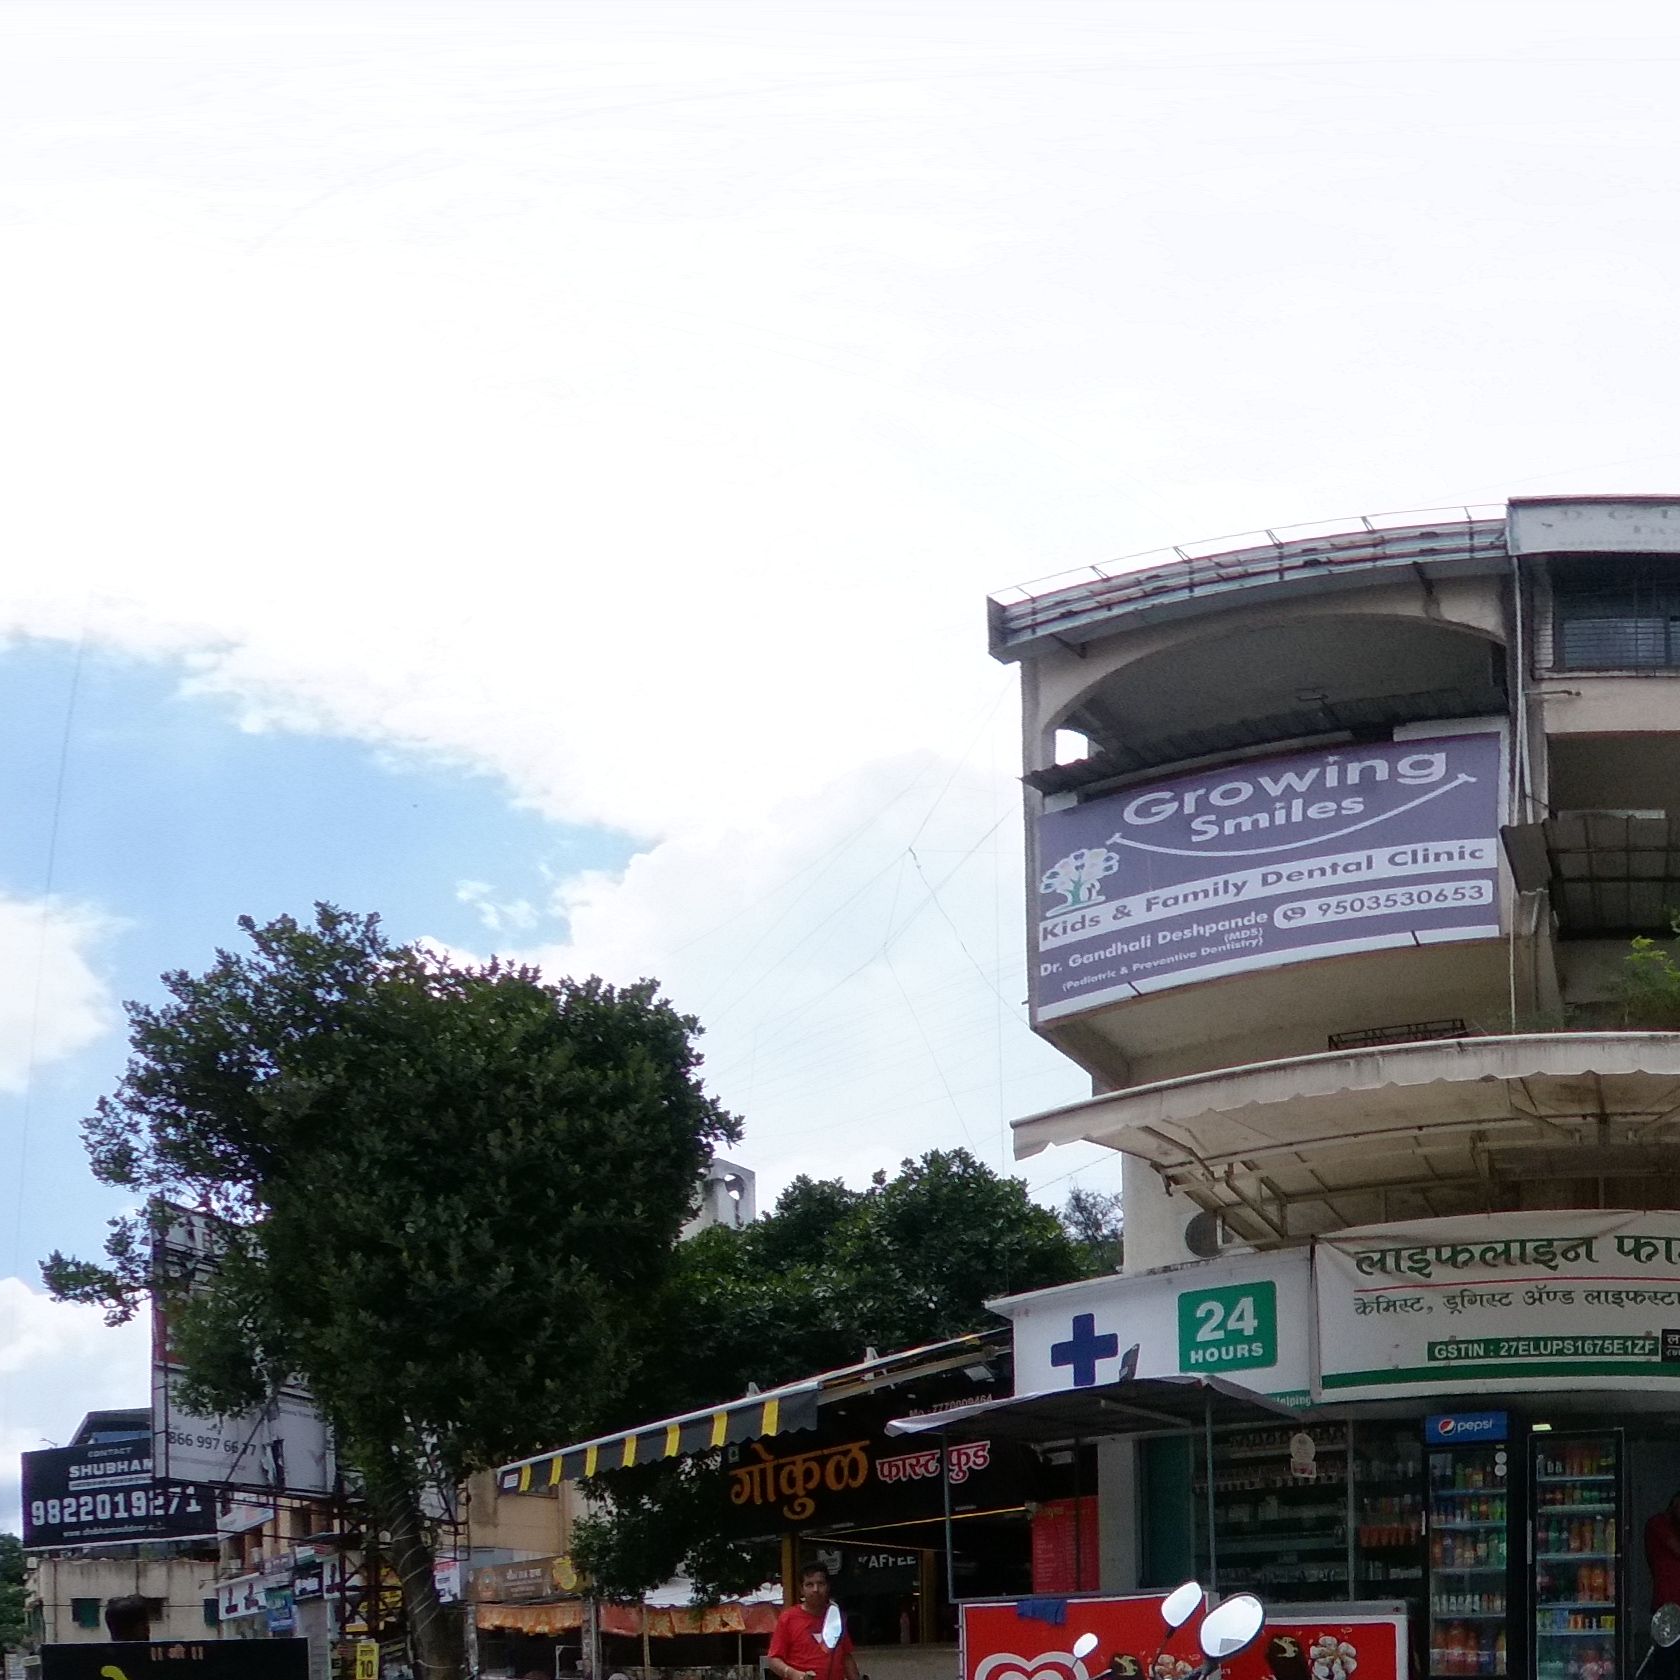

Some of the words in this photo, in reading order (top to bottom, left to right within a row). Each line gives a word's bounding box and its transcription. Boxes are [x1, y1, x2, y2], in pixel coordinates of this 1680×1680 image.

[1123, 752, 1446, 826] Growing
[1191, 797, 1365, 843] Smiles
[1042, 914, 1101, 943] Kids
[1112, 904, 1134, 922] &
[1146, 879, 1248, 913] Family
[1261, 854, 1373, 888] Dental
[1388, 841, 1484, 867] Clinic
[1318, 885, 1485, 917] 9503530653
[1039, 962, 1063, 977] Dr.
[1068, 933, 1152, 971] Gandhali
[1157, 911, 1269, 948] Deshpande
[1132, 951, 1197, 972] Preventive
[1354, 1235, 1599, 1279] लाइफलाइन
[1354, 1295, 1435, 1316] केमिस्ट,
[1196, 1297, 1258, 1342] 24
[1190, 1342, 1263, 1364] HOURS
[1434, 1343, 1485, 1358] GSTIN
[1457, 1419, 1493, 1433] pepsi
[87, 1447, 132, 1458] CONTACT
[197, 1435, 220, 1450] 997
[728, 1440, 870, 1520] गोकुळ
[876, 1450, 941, 1484] फास्ट
[947, 1440, 991, 1484] फुड
[360, 1660, 374, 1678] 10
